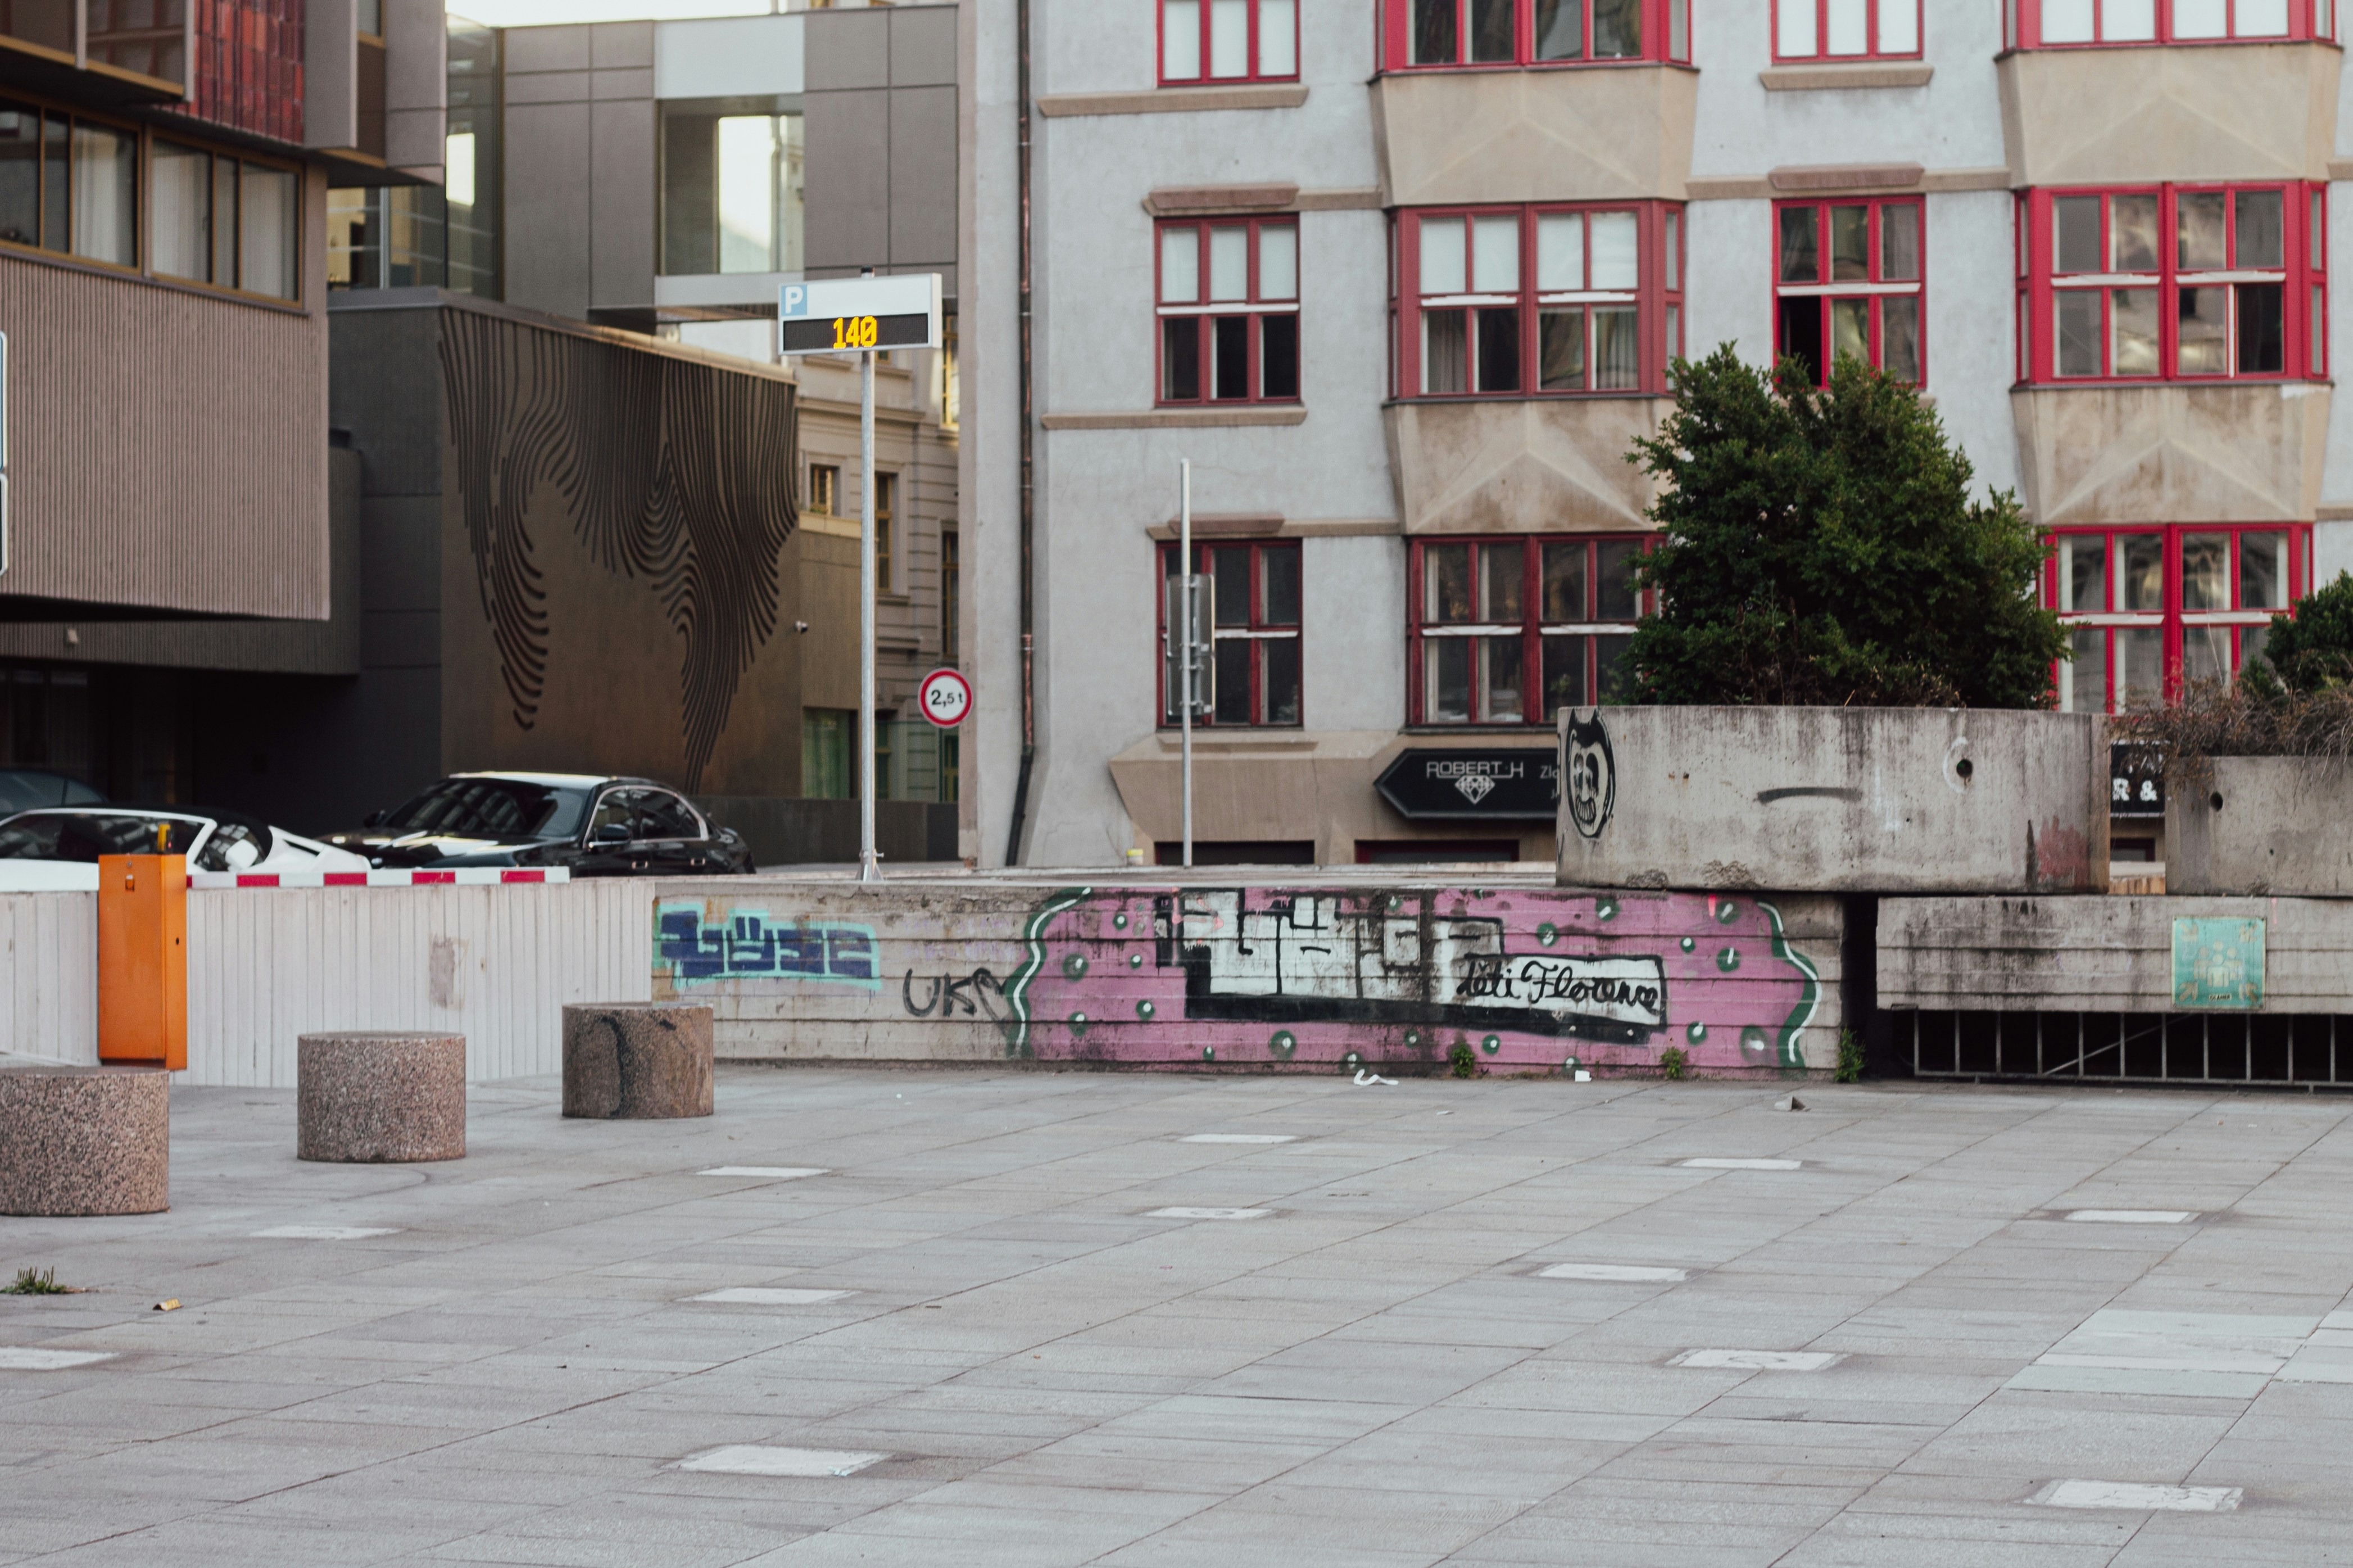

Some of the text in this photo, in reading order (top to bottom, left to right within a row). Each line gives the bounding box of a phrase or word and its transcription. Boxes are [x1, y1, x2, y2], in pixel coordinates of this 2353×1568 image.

[785, 286, 803, 314] P
[832, 315, 877, 349] 140
[931, 689, 955, 708] 2,5
[1426, 761, 1503, 778] ROBERT
